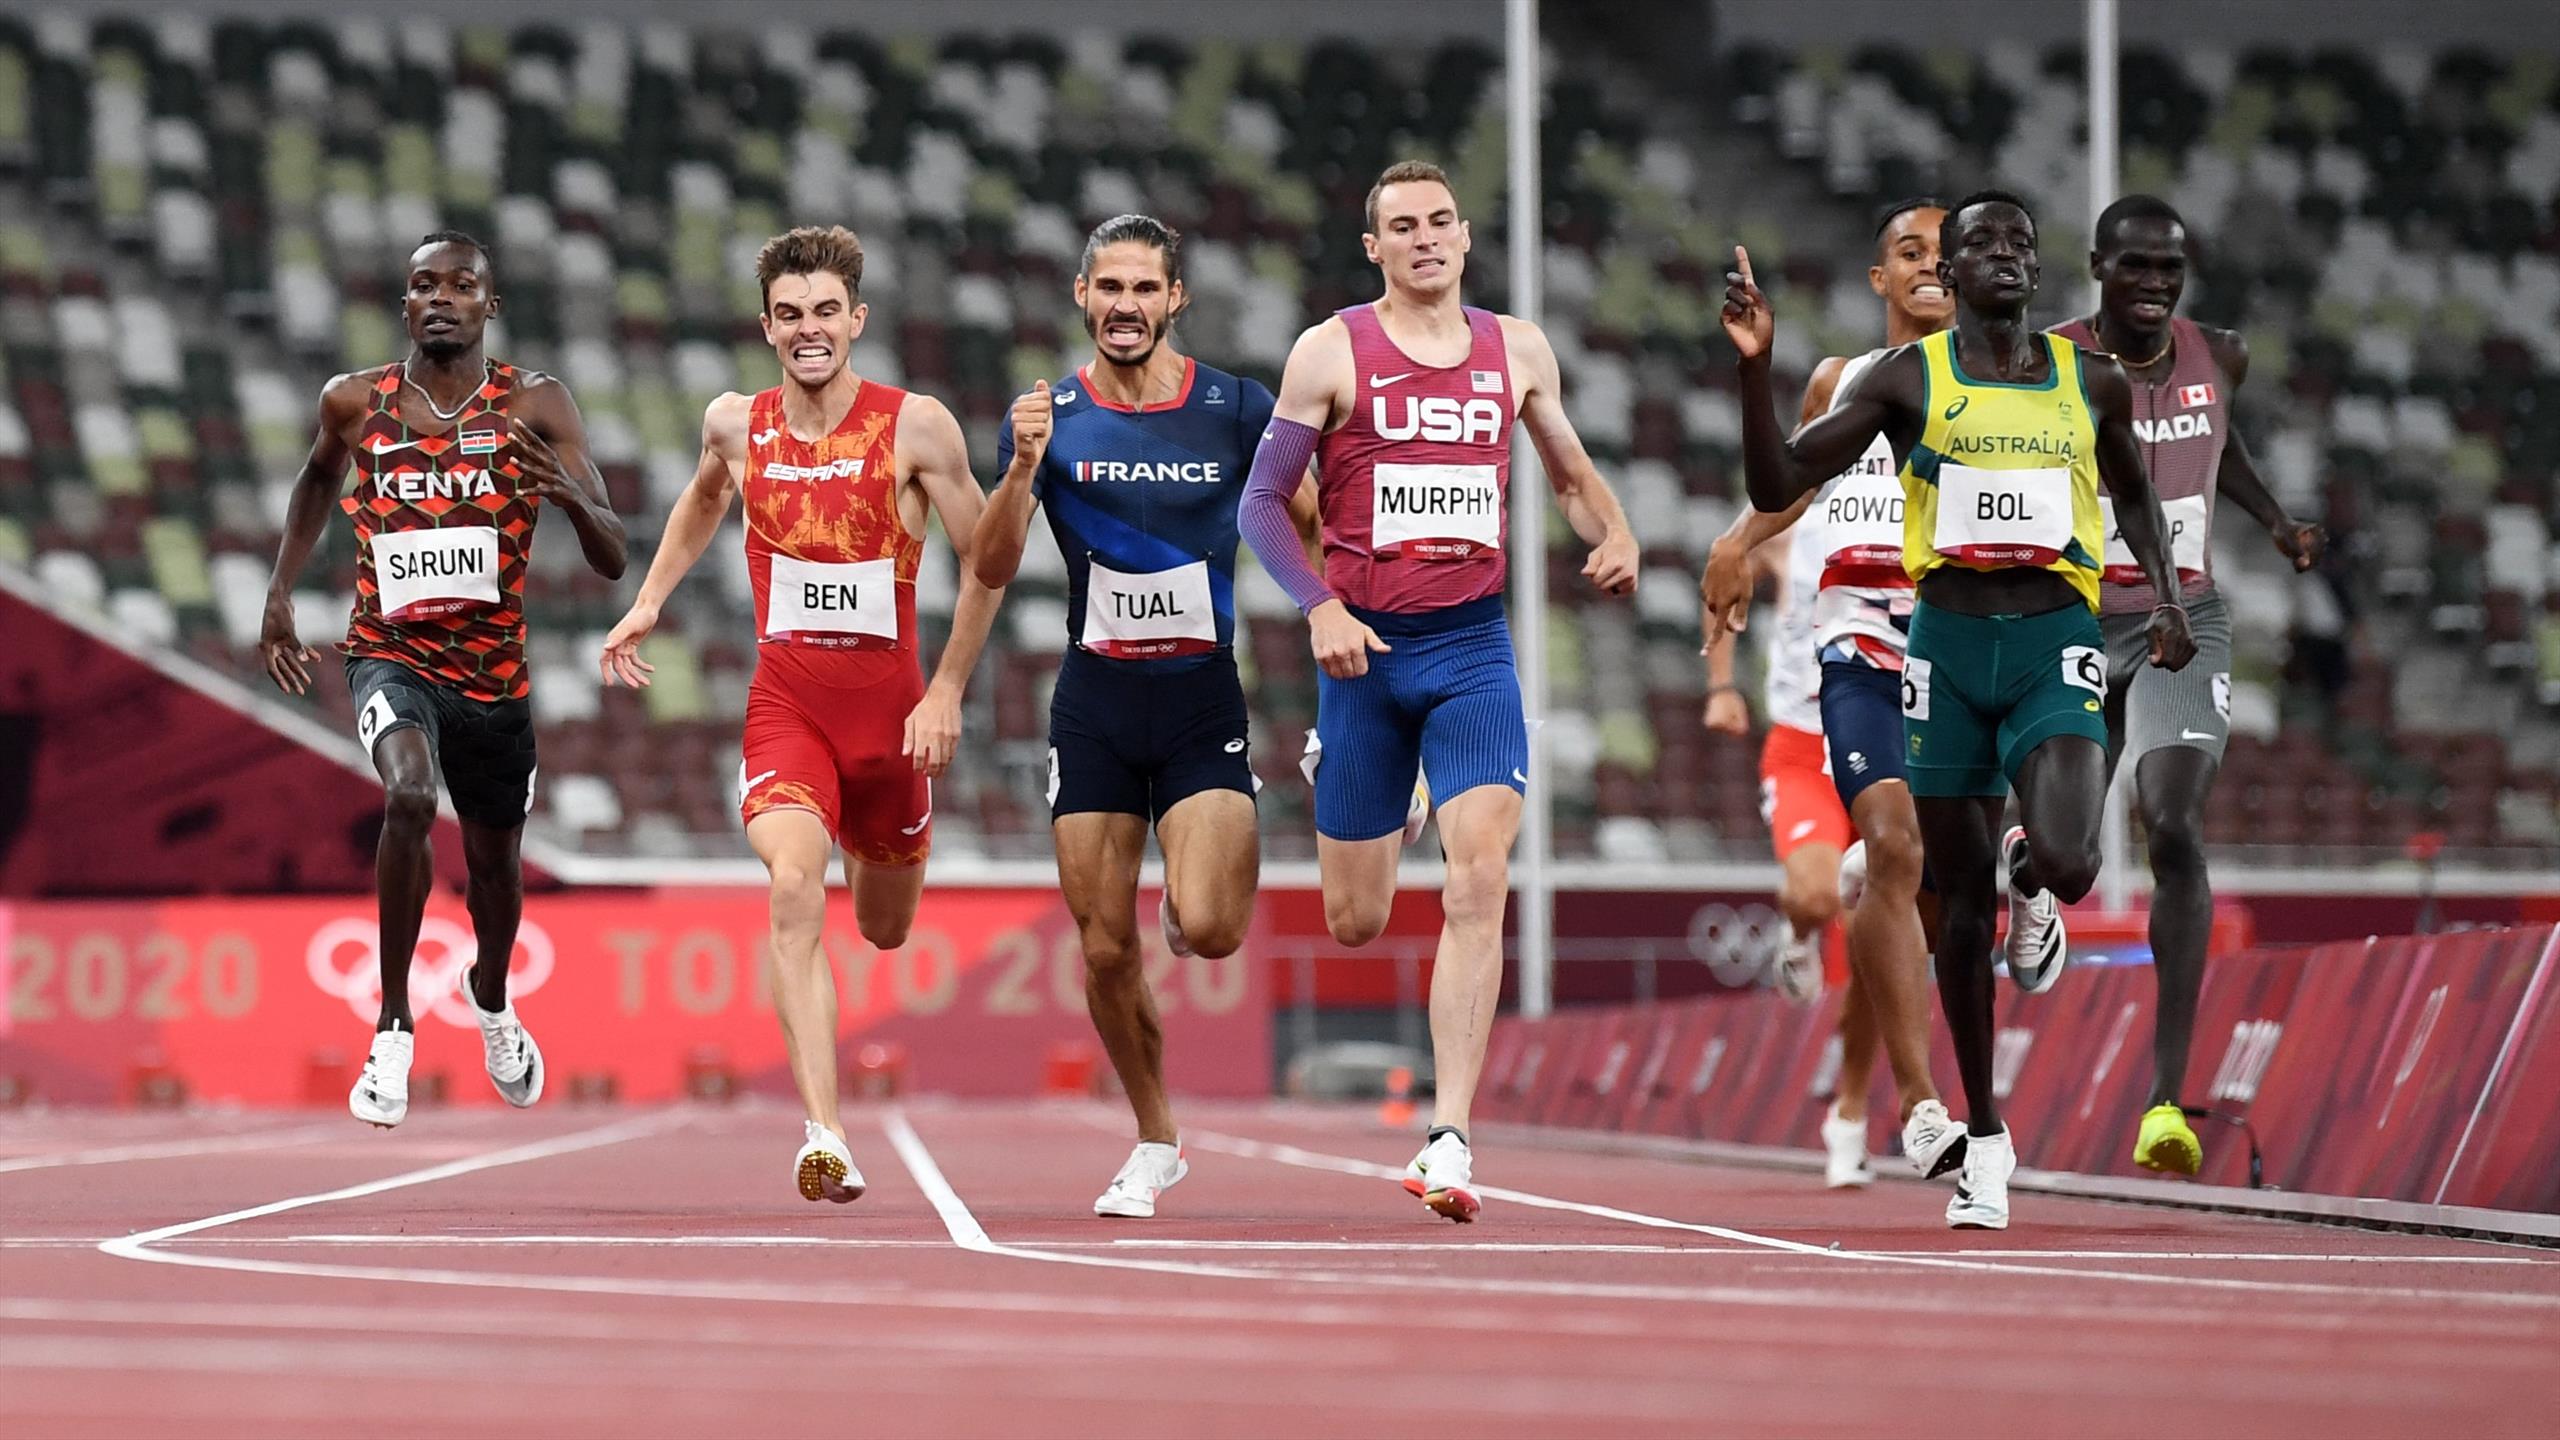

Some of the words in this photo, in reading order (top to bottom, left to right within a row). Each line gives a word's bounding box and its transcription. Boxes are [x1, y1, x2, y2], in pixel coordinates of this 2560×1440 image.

[1372, 396, 1502, 444] USA
[1950, 435, 2073, 460] AUSTRALIA
[373, 469, 497, 500] KENYA
[1092, 461, 1222, 483] FRANCE
[1380, 485, 1494, 516] MURPHY
[1828, 496, 1906, 524] ROWD
[1976, 492, 2033, 521] BOL
[389, 547, 484, 581] SARUNI
[804, 582, 857, 611] BEN
[1111, 590, 1184, 620] TUAL
[2077, 652, 2103, 688] 6
[361, 705, 377, 737] 9
[10, 931, 260, 1020] 2020
[605, 929, 957, 1015] TOYO
